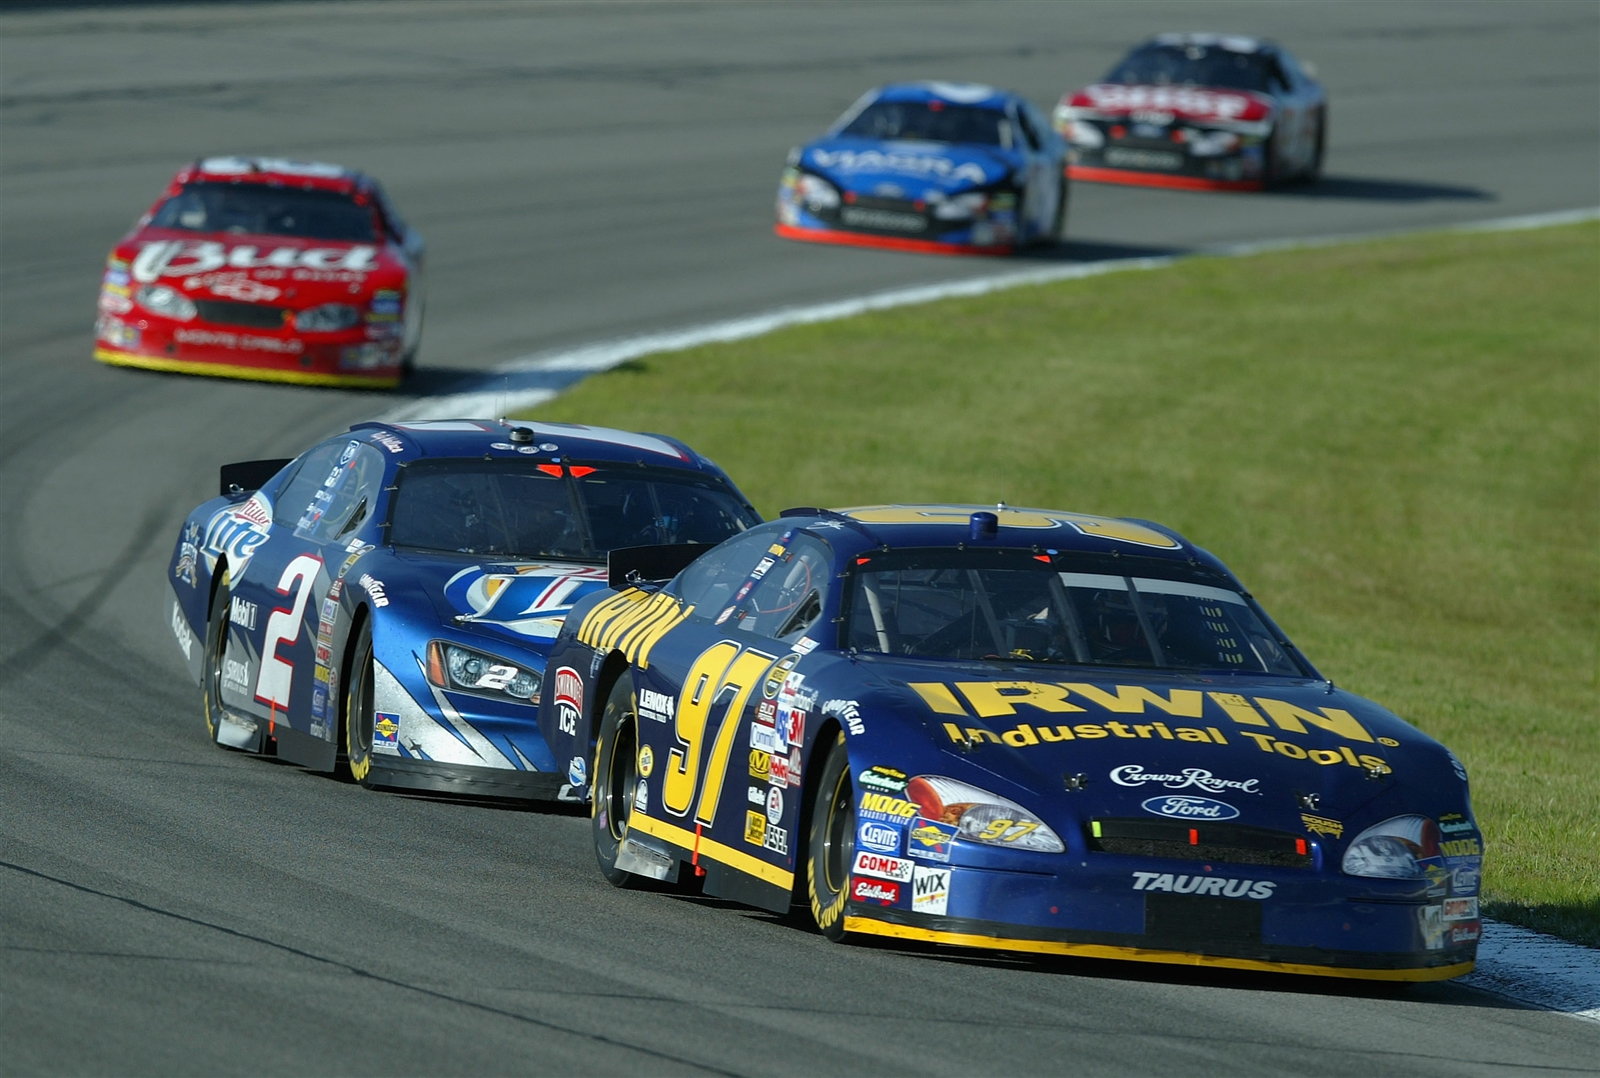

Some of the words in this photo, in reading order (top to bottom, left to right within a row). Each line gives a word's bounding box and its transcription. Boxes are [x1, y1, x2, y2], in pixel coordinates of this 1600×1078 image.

[132, 241, 376, 282] Bud
[240, 499, 270, 525] Miller
[200, 511, 270, 559] Lite
[254, 553, 324, 712] 2
[577, 587, 695, 671] IRWIN
[475, 665, 519, 690] 2
[639, 688, 668, 714] LENOX
[907, 682, 1375, 743] IRWIN
[559, 705, 577, 736] ICE
[821, 699, 866, 736] GOODYEAR
[662, 640, 778, 828] 97
[943, 721, 1229, 747] Industrial
[1240, 731, 1392, 774] Tools
[1110, 765, 1184, 786] Crown
[1164, 768, 1259, 793] Royal
[859, 792, 921, 818] MOOG
[1161, 797, 1221, 818] Ford
[861, 822, 898, 846] CLEVITE
[912, 828, 952, 844] SUNOCO
[979, 819, 1041, 842] 97
[1439, 838, 1480, 857] MOOG
[859, 855, 898, 873] COMP
[915, 872, 947, 895] WIX
[1132, 872, 1277, 900] TAURUS
